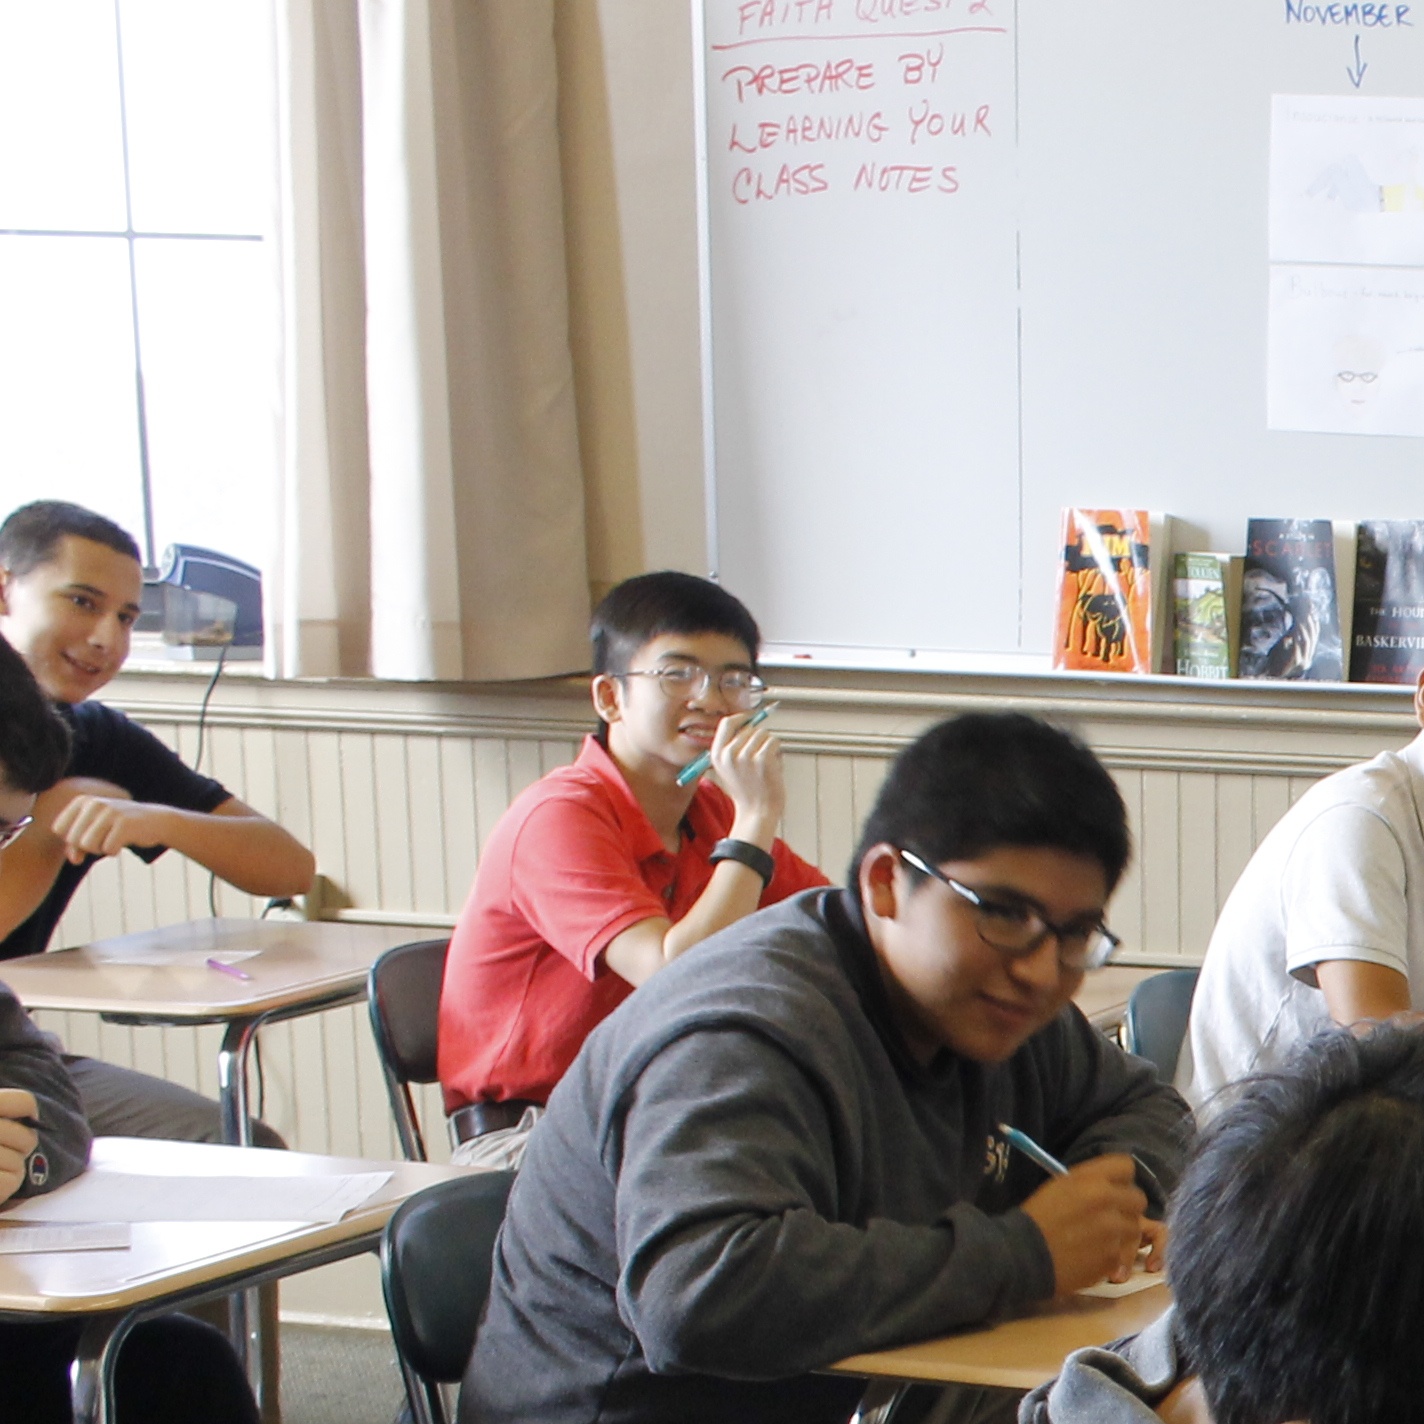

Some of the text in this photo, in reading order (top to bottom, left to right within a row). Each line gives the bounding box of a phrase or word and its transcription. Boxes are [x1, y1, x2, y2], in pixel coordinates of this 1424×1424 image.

[738, 0, 832, 34] FAITH
[1285, 0, 1414, 28] NOVEMBER
[722, 43, 944, 103] PREPARE BY
[729, 99, 993, 153] LEARNING YOUR
[732, 161, 959, 204] CLASS NOTES
